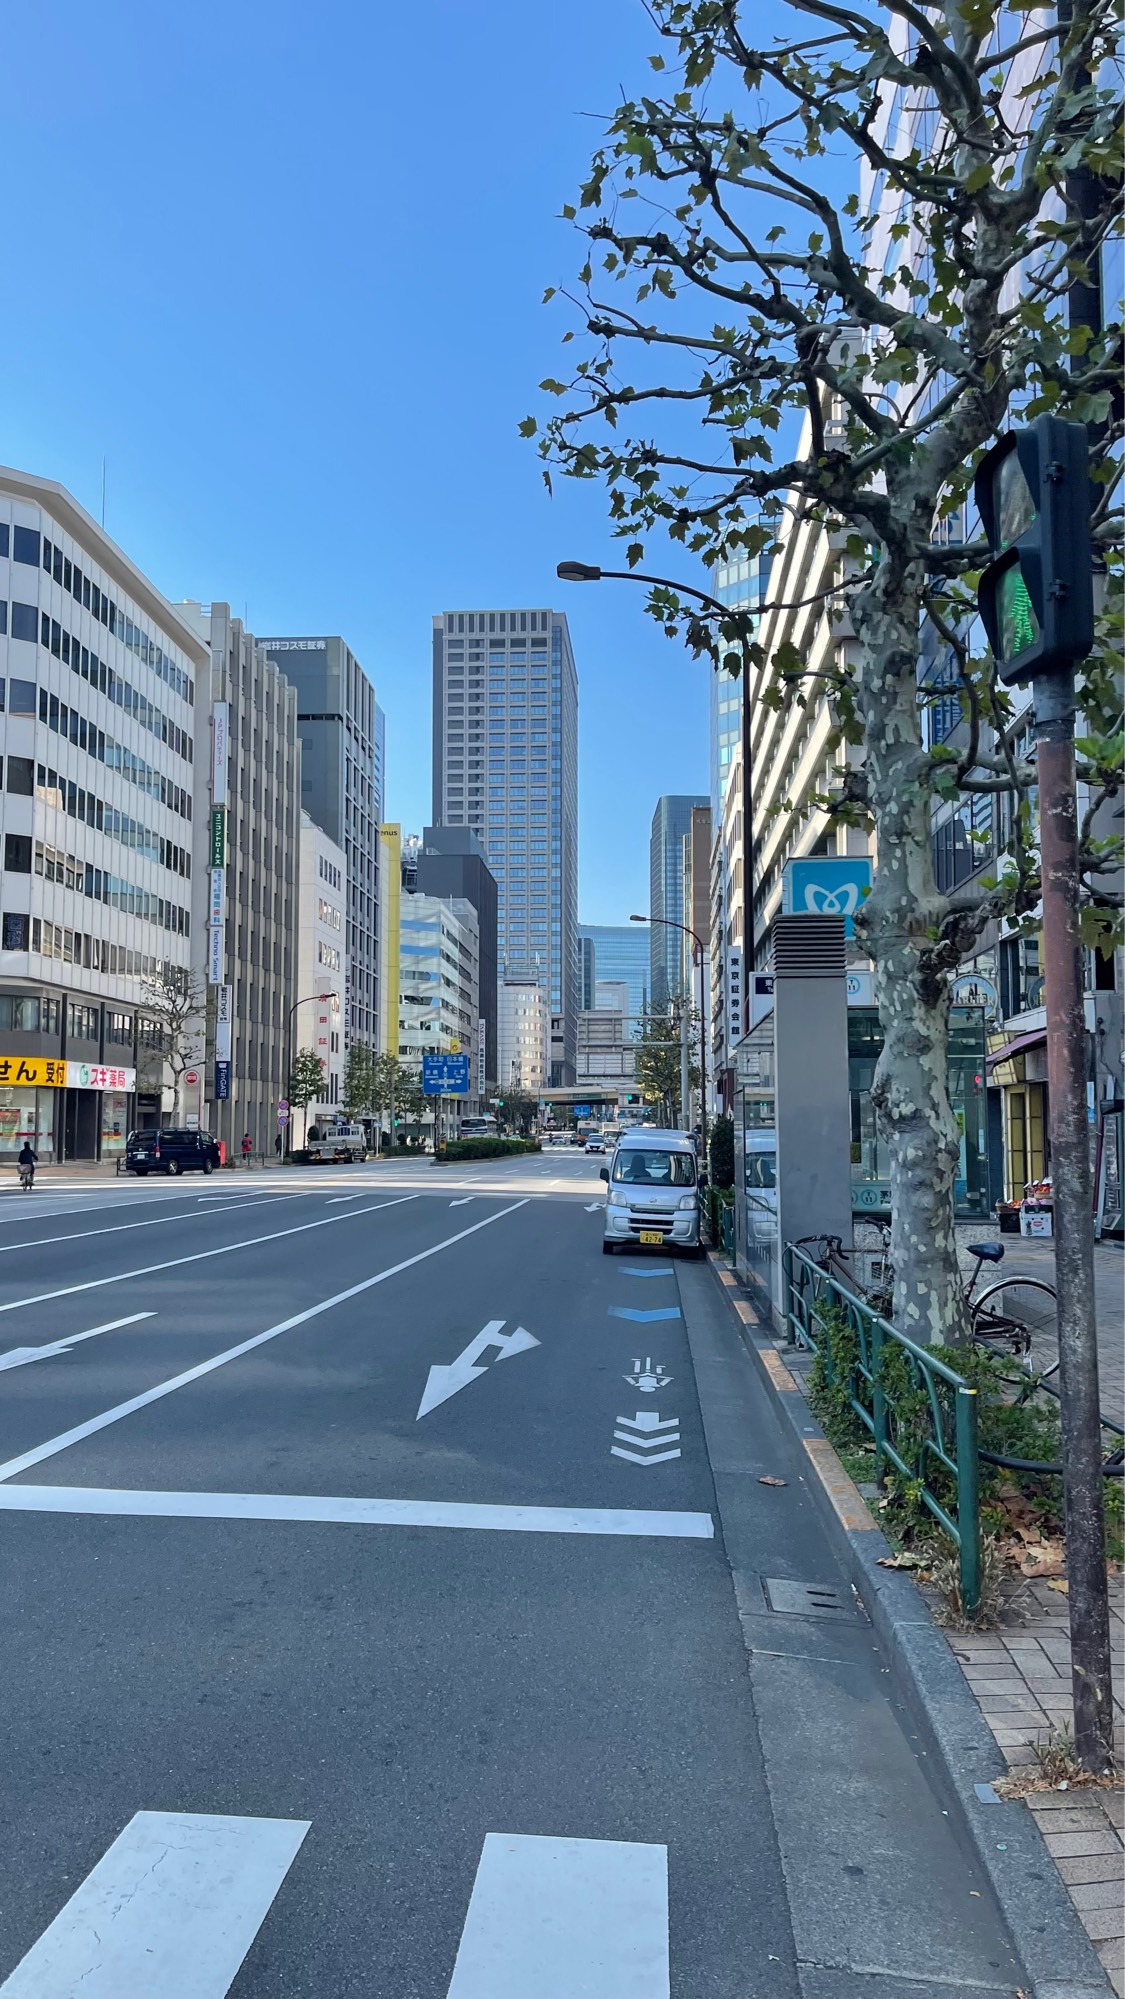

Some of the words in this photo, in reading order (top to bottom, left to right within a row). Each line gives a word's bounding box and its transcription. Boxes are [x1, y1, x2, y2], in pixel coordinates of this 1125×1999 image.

[261, 641, 326, 650] 岩井コスモ証券
[731, 958, 740, 1035] 東京証券会館
[46, 1062, 65, 1084] 受付
[90, 1067, 126, 1088] スギ薬局
